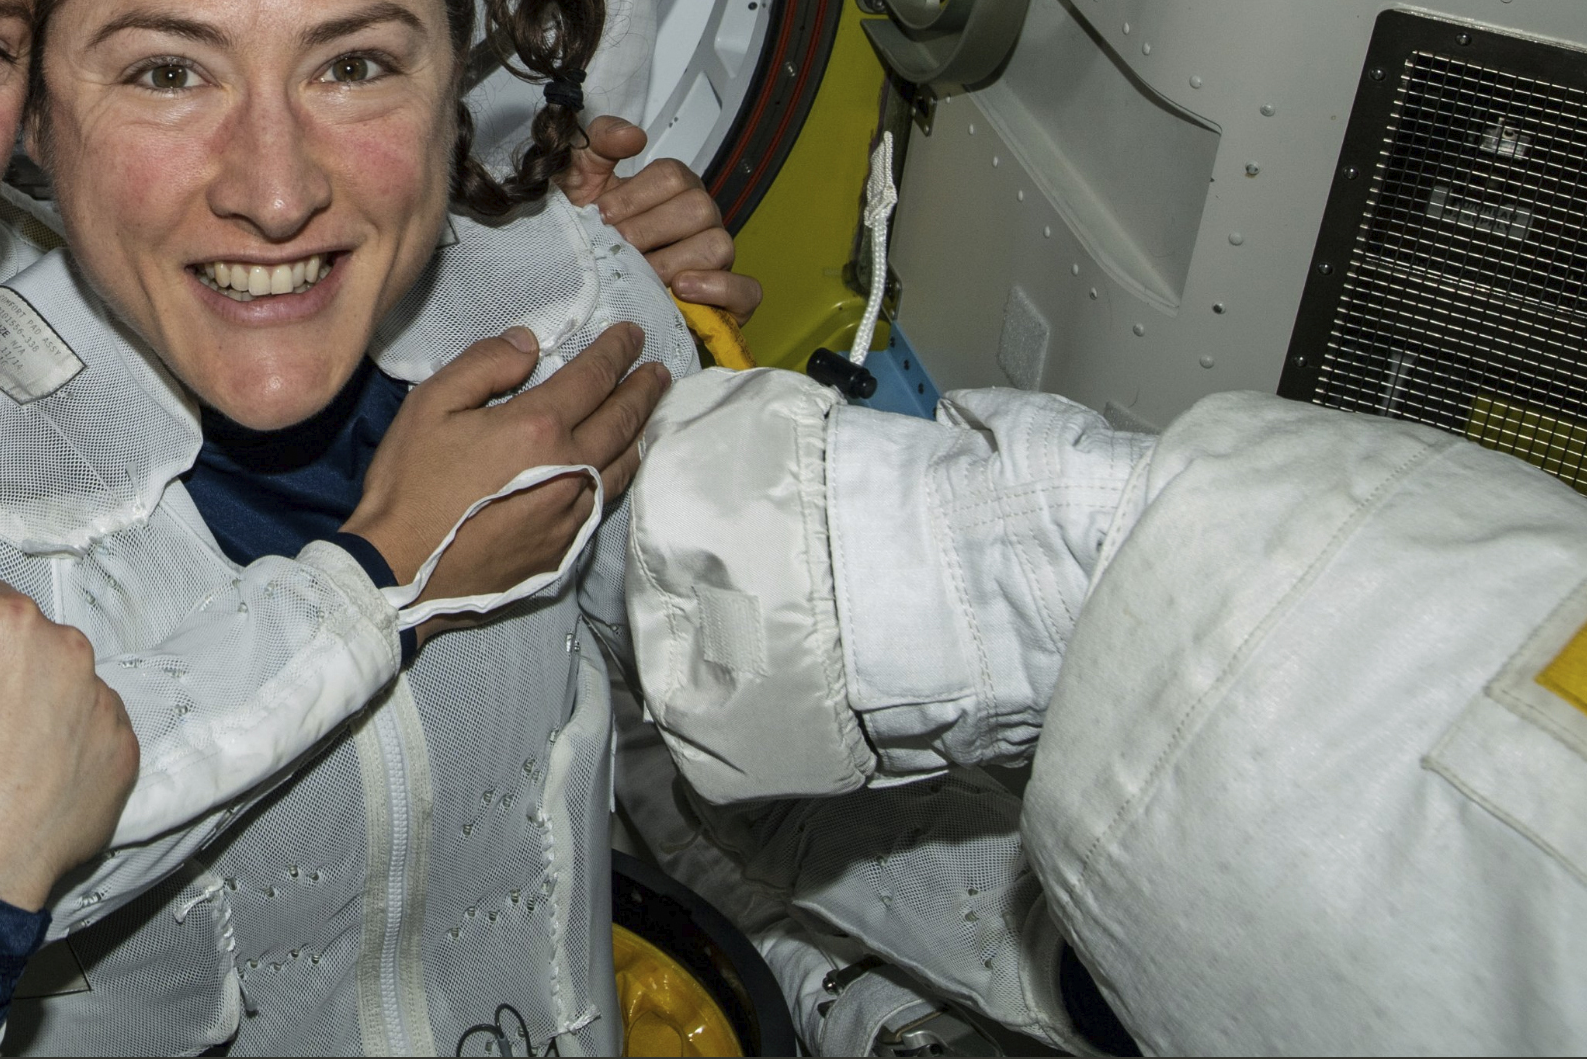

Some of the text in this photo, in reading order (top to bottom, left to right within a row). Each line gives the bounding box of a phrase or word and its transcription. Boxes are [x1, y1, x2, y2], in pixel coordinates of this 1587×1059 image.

[11, 339, 26, 356] N/A
[26, 318, 43, 337] PAD
[41, 337, 62, 357] ASSY
